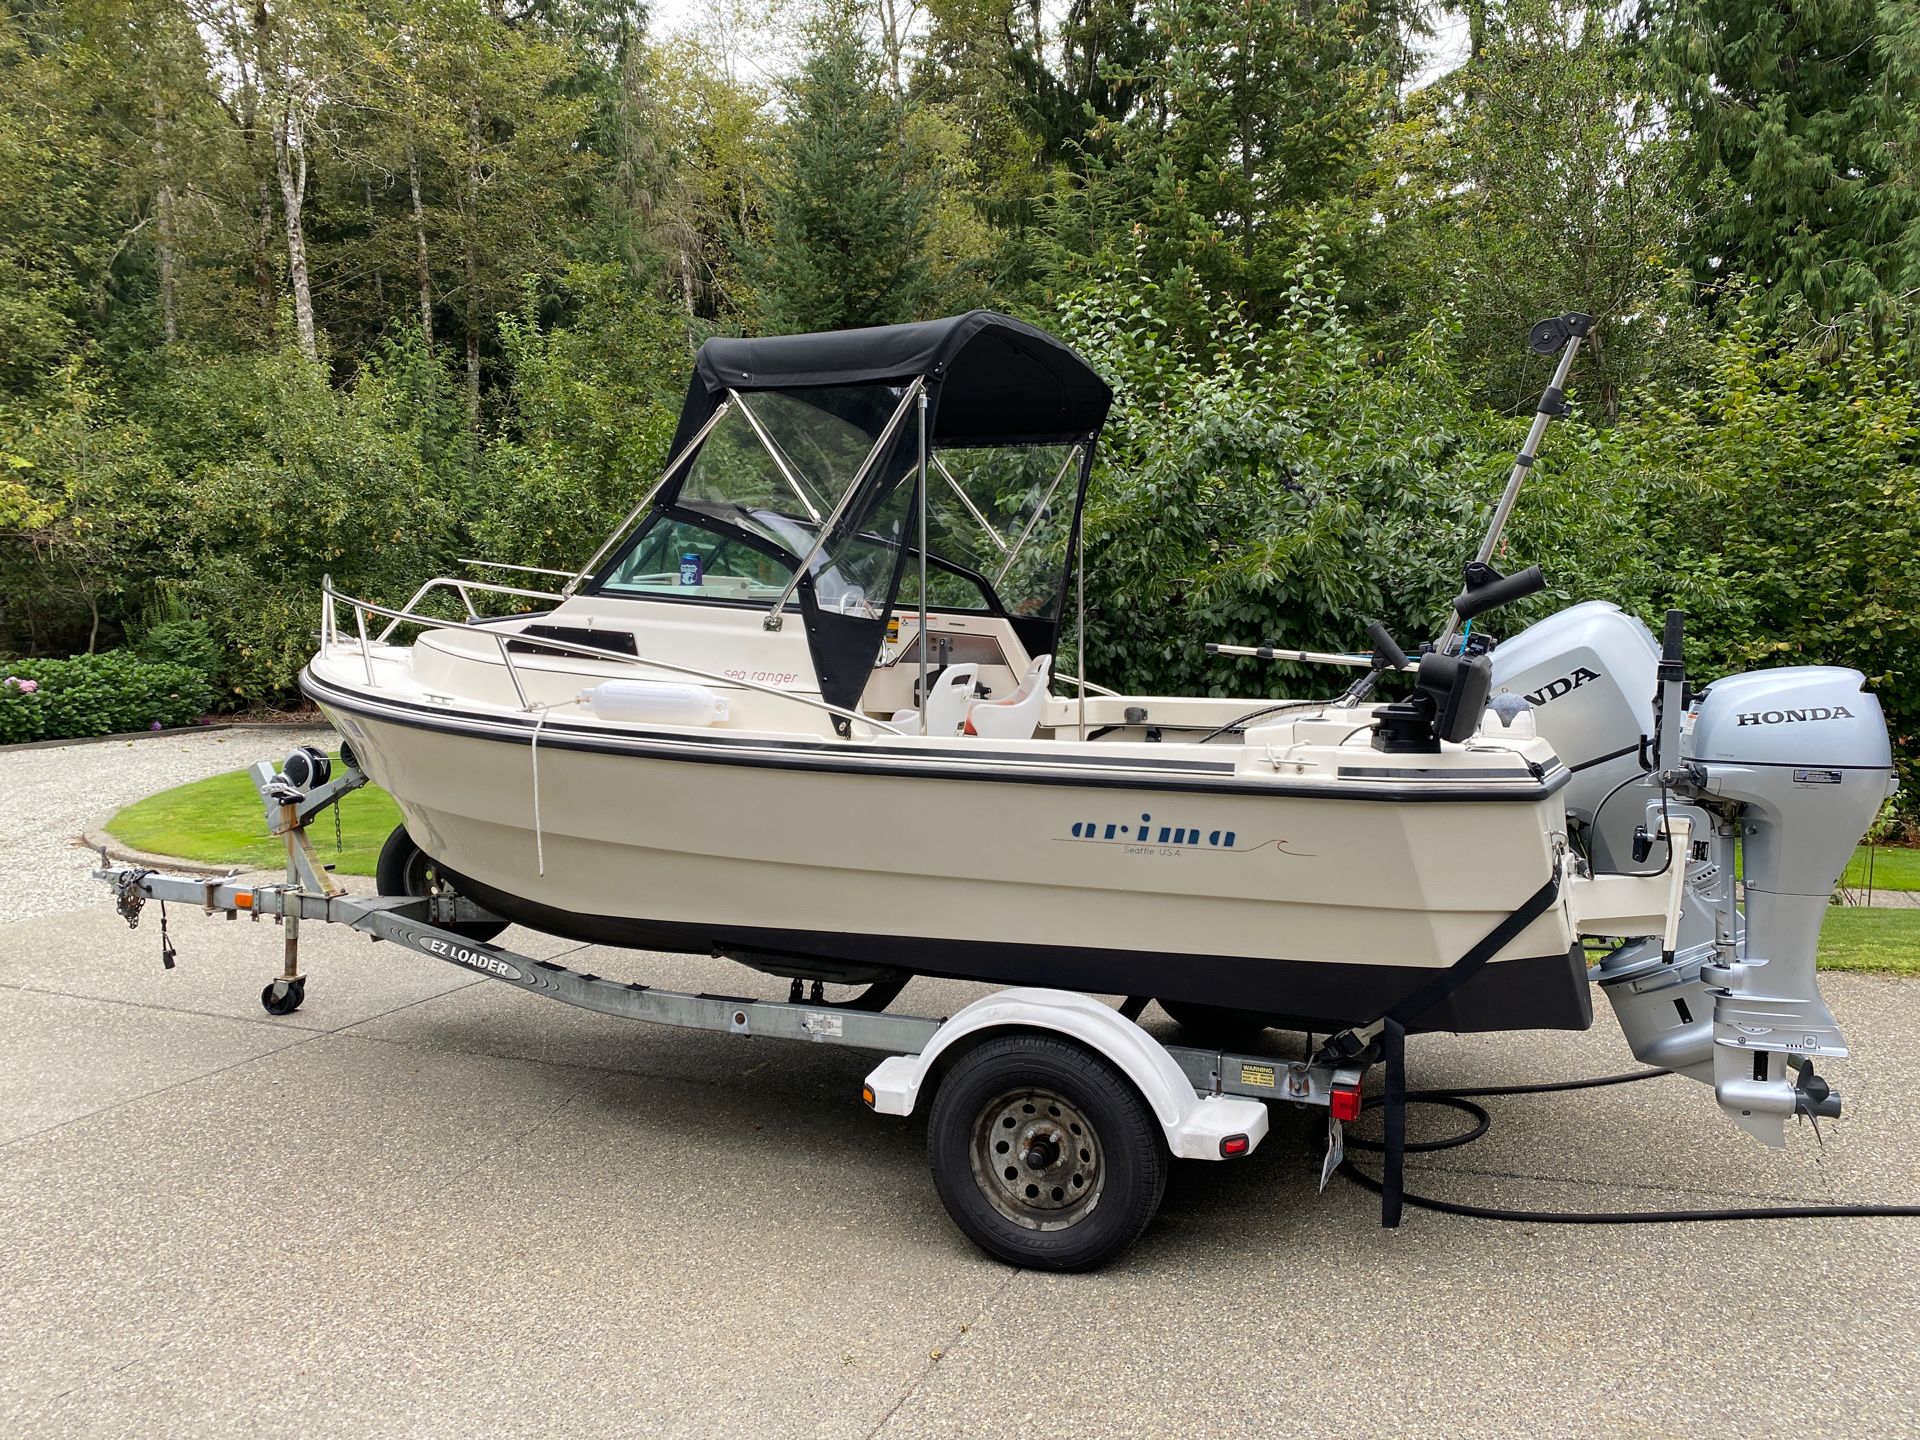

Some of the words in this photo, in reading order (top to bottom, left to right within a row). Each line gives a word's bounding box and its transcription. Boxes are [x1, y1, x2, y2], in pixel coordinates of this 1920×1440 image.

[724, 669, 746, 680] sea
[751, 671, 798, 685] ranger
[1523, 667, 1601, 709] NDA
[1736, 706, 1855, 726] HONDA
[1071, 813, 1236, 847] arima
[1123, 845, 1154, 856] Seattle
[1159, 847, 1181, 857] USA
[430, 939, 448, 956] EZ
[450, 946, 509, 977] LOADER
[1243, 1064, 1273, 1074] WARNING
